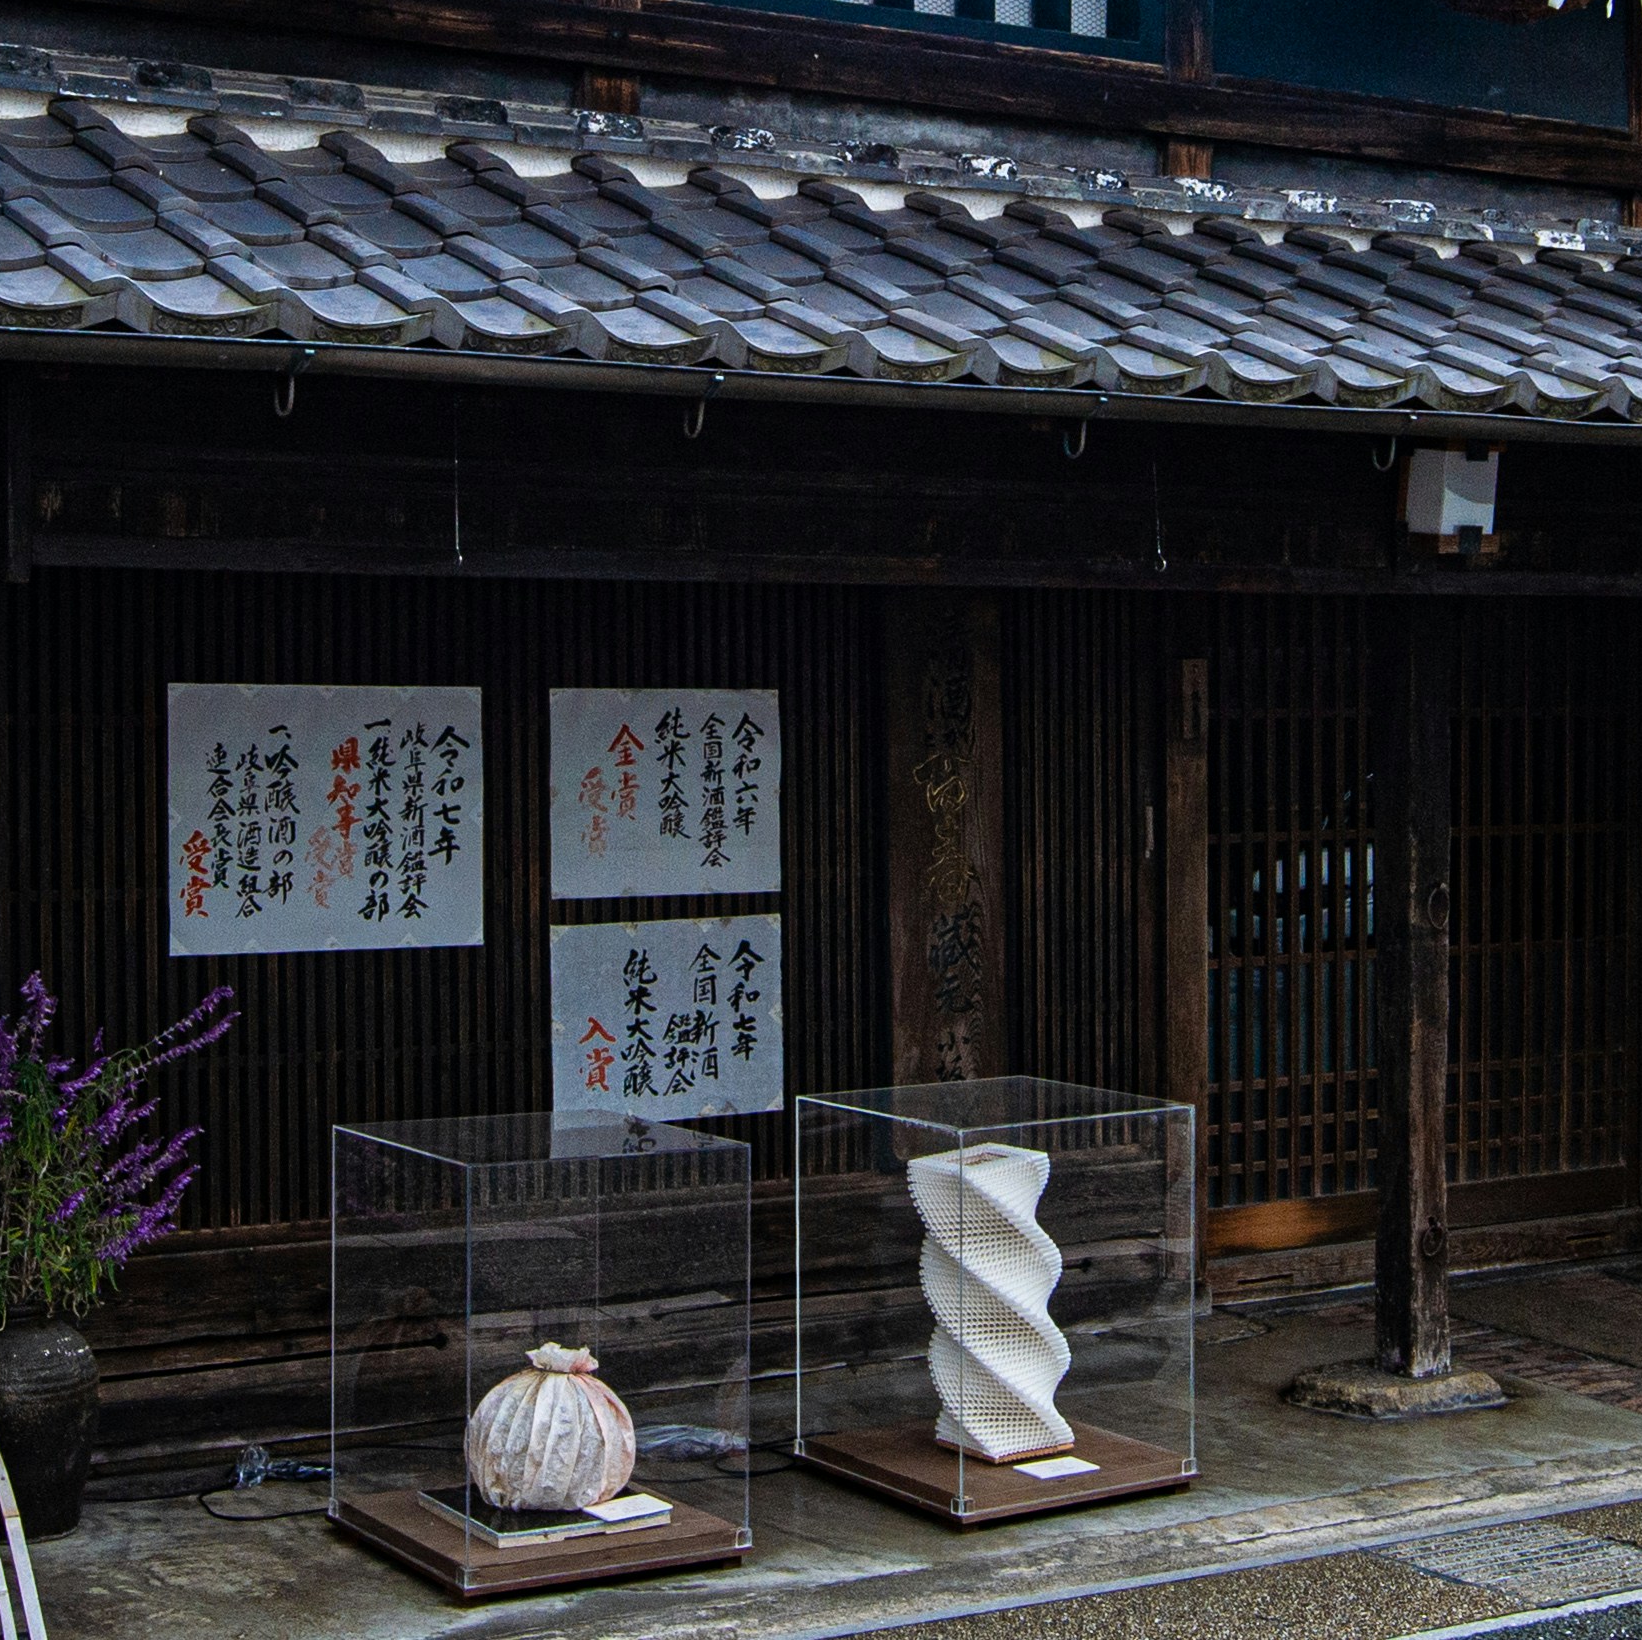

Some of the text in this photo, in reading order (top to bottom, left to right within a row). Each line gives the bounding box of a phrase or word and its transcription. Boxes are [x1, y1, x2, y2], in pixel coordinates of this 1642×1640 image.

[204, 742, 236, 890] 連合会長賞
[235, 742, 263, 919] 岐阜県酒造組合
[325, 736, 364, 880] 県知事賞
[394, 721, 431, 920] 岐阜県新酒鑑評会
[427, 725, 471, 867] 令和七年
[577, 765, 611, 859] 受賞
[606, 722, 645, 822] 金賞
[653, 706, 692, 840] 純米大吟醸
[698, 711, 732, 869] 全国新酒鑑評会
[730, 712, 765, 837] 令和六年
[177, 829, 213, 919] 受賞
[303, 825, 334, 910] 受賞
[577, 1016, 617, 1093] 入賞
[619, 948, 660, 1098] 純米大吟醸
[662, 1012, 695, 1096] 鑑評会
[688, 942, 723, 1082] 全国新酒
[726, 939, 766, 1062] 令和七年
